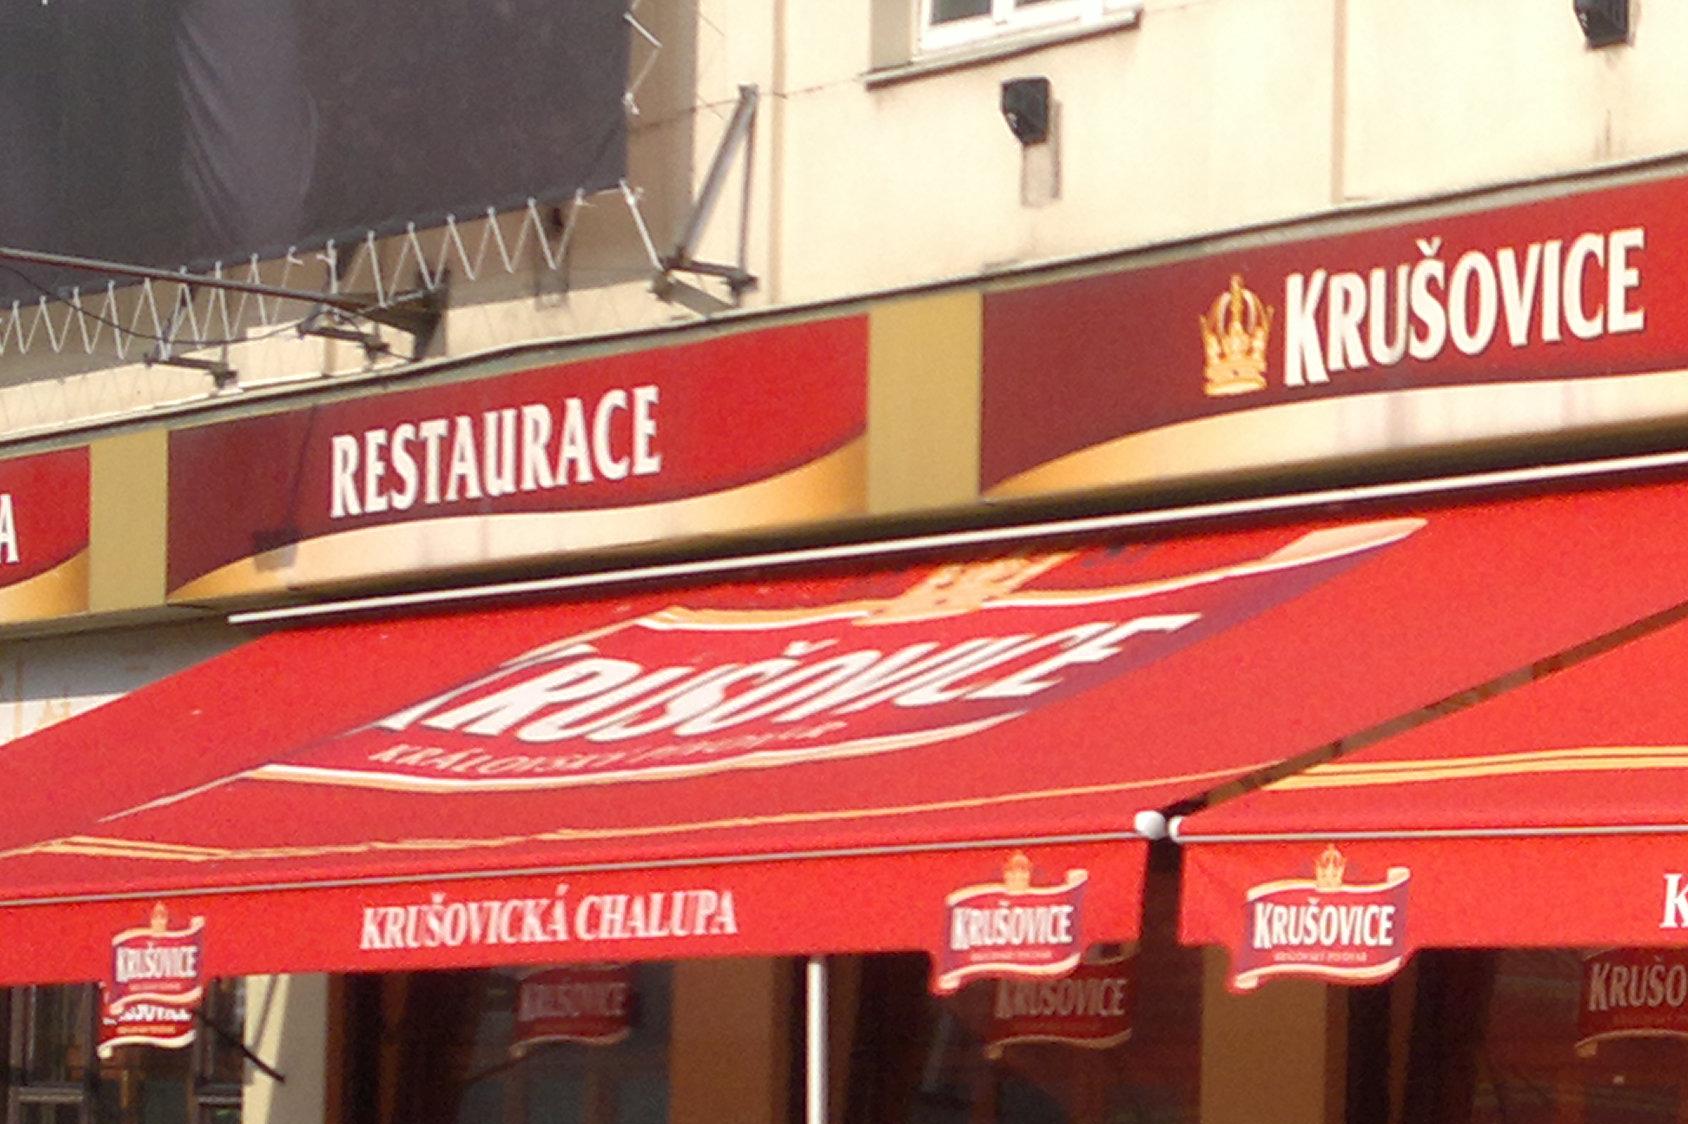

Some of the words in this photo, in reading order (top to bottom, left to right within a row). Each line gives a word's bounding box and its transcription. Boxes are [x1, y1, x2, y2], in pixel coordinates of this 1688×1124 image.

[1284, 228, 1645, 387] KRUŠOVICE
[330, 385, 662, 518] RESTAURACE
[374, 612, 1202, 743] KRUŠOVICE
[360, 884, 573, 949] KRUŠOVICKÁ
[575, 889, 739, 940] CHALUPA
[951, 900, 1075, 950] KRUŠOVICE
[1253, 897, 1397, 949] KRUŠOVICE
